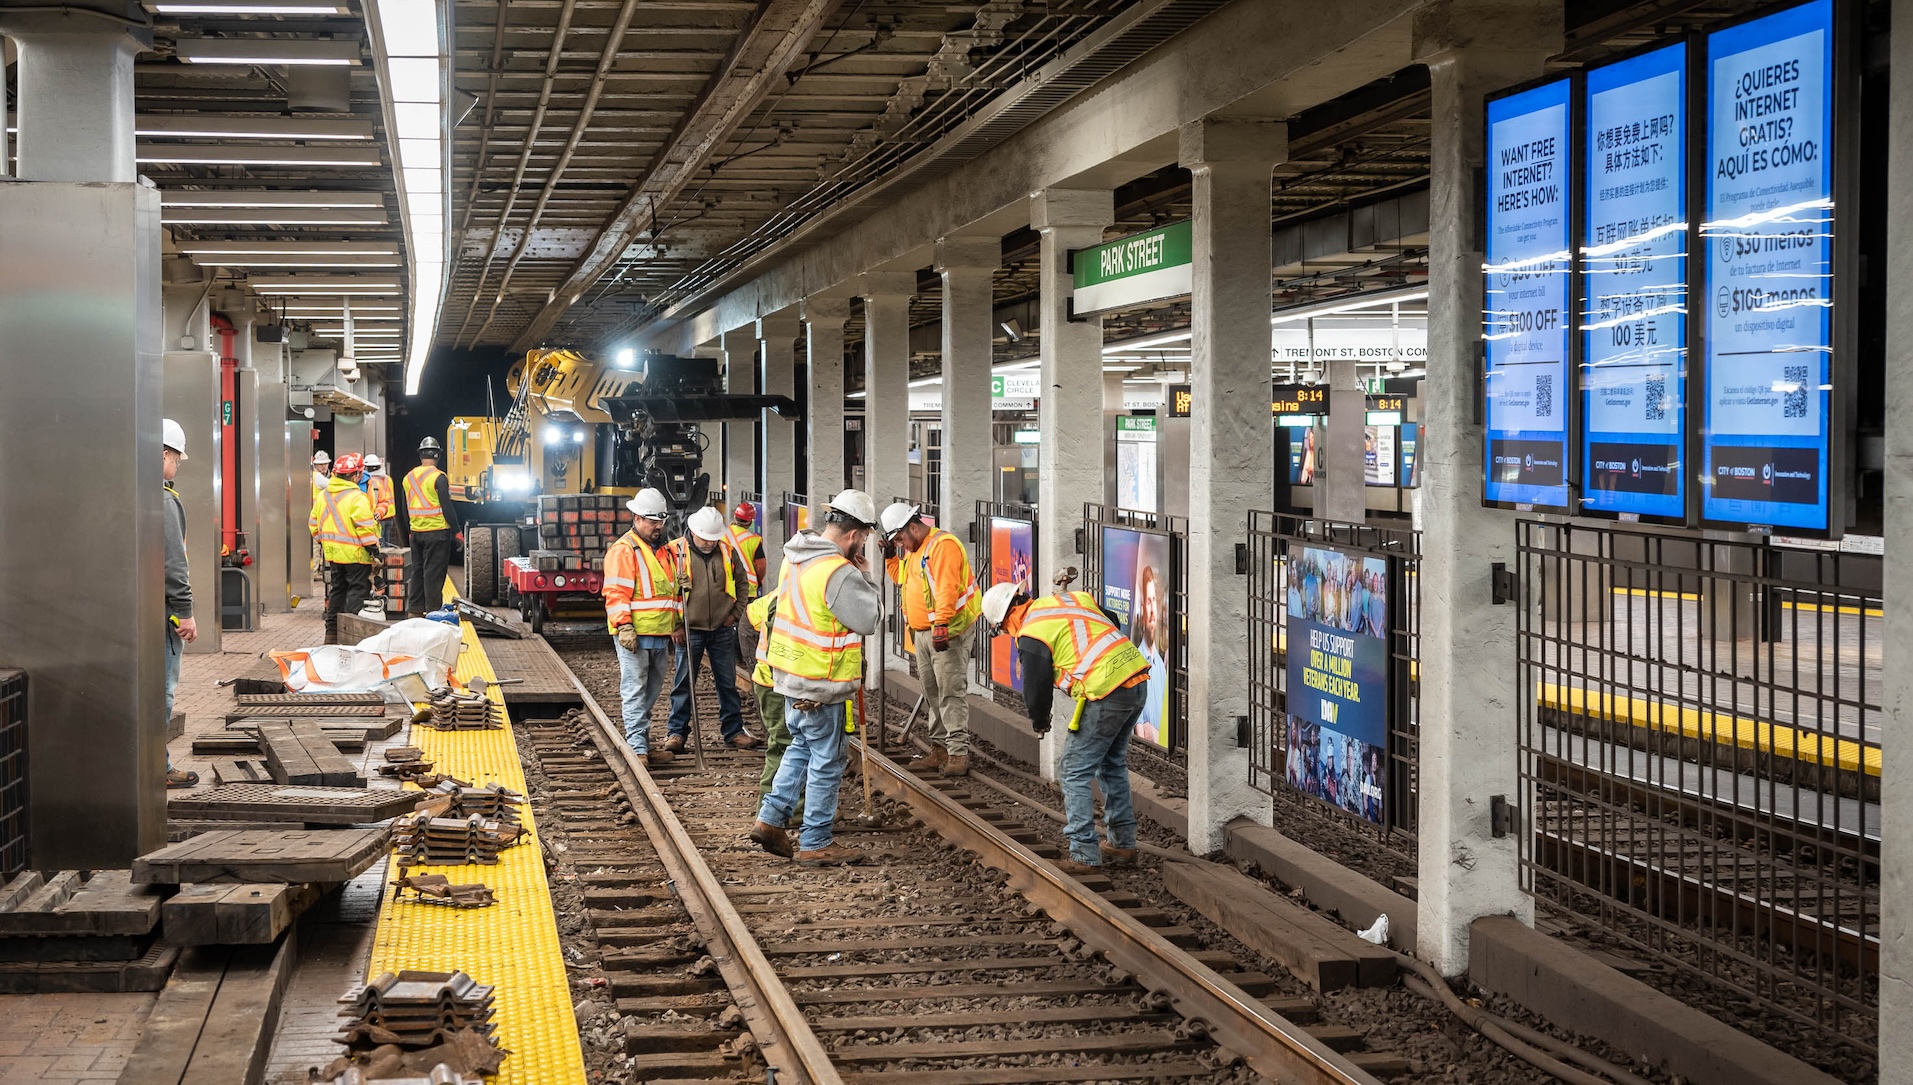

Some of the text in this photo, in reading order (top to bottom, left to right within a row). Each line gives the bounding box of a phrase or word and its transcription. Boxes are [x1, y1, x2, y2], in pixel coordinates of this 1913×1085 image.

[1735, 59, 1799, 99] ¿QUIERES
[1735, 87, 1800, 121] INTERNET
[1597, 114, 1674, 152] 你想要免费上网吗？
[1739, 116, 1793, 148] GRATIS?
[1501, 137, 1555, 166] WANT FREE
[1605, 143, 1663, 174] 具体方法如下：
[1717, 139, 1818, 180] AQUÍ ES CÓMO:
[1503, 162, 1553, 189] INTERNET?
[1497, 184, 1559, 213] HERE'S HOW:
[1749, 188, 1756, 198] de
[1100, 233, 1165, 278] PARK STREET
[1736, 228, 1814, 258] $30 menos
[1630, 247, 1653, 275] 美元
[1729, 259, 1802, 277] de tu factura de Internet
[1732, 286, 1816, 315] $100 menos
[1509, 308, 1558, 336] $100 OFF
[1611, 320, 1657, 347] 100 美元
[1734, 316, 1795, 335] un dispositivo digital
[1340, 348, 1356, 358] ST,
[1359, 347, 1403, 357] BOSTON
[992, 380, 1001, 393] C
[1297, 389, 1324, 402] 8:14
[224, 403, 231, 413] G
[1378, 399, 1402, 410] 8:14
[224, 413, 231, 427] 7
[1124, 418, 1153, 430] PARK STREET
[1317, 446, 1324, 470] C
[1595, 461, 1605, 469] CITY
[1609, 461, 1626, 470] BOSTON
[1718, 466, 1729, 476] CITY
[1734, 466, 1756, 477] BOSTON
[1105, 584, 1131, 600] SUPPORT MORE
[1106, 597, 1130, 612] VICTORIES FOR
[1309, 628, 1355, 659] HELP US SUPPORT
[1310, 649, 1352, 679] OVER A MILLION
[1303, 666, 1361, 703] VETERANS EACH YEAR.
[1320, 698, 1339, 725] DAV
